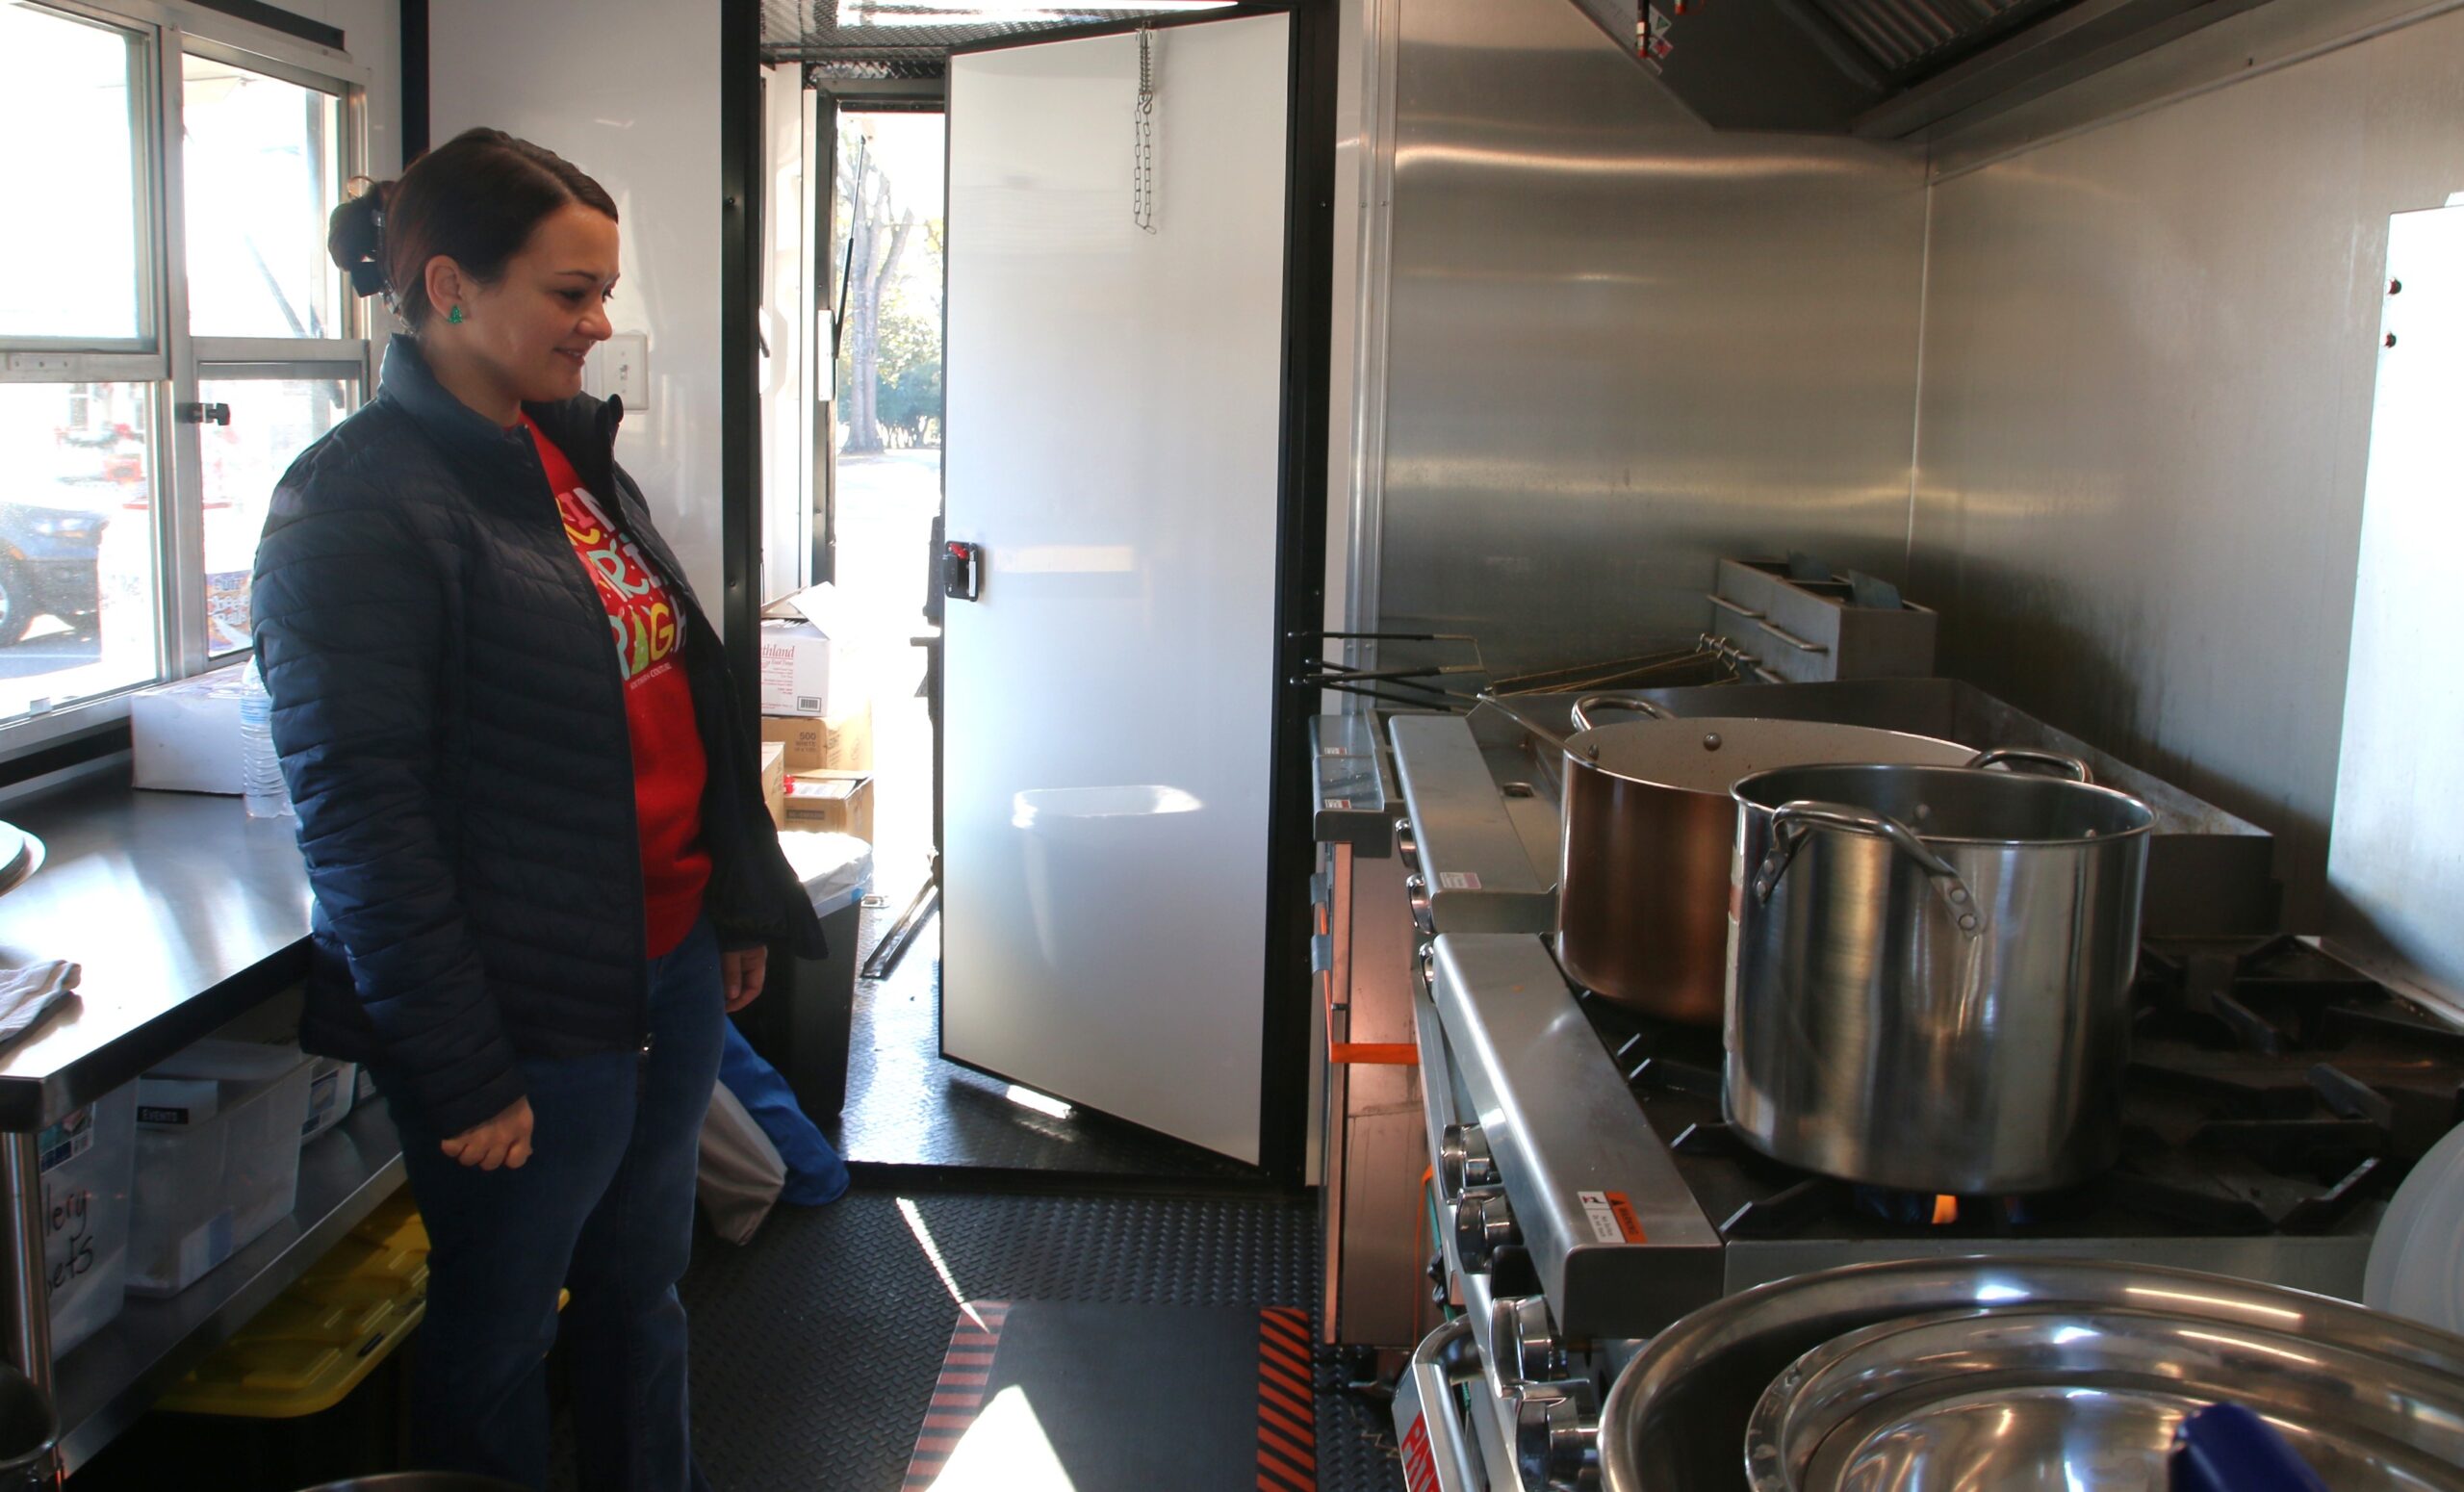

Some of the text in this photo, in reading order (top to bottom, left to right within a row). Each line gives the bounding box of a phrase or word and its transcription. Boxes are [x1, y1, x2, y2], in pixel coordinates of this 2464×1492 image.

[761, 644, 795, 658] thland
[799, 732, 816, 740] 500
[45, 1183, 88, 1240] lery
[45, 1235, 94, 1297] ets
